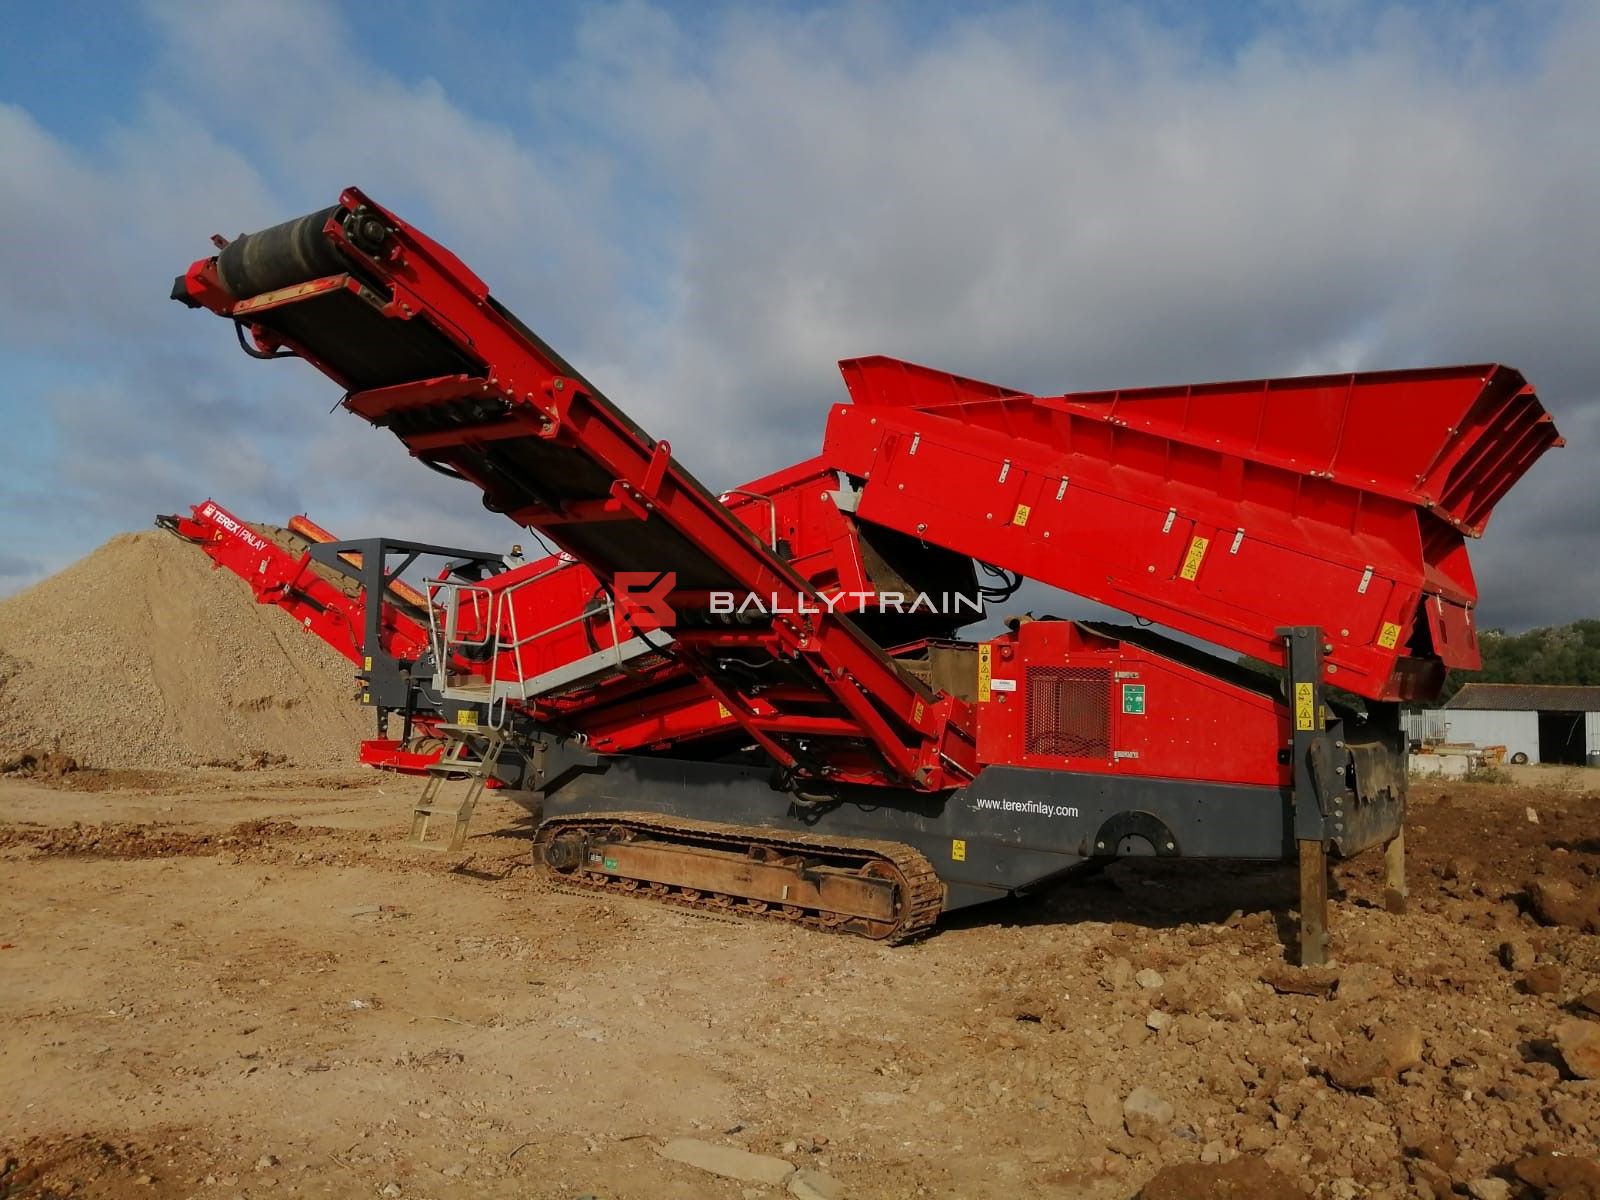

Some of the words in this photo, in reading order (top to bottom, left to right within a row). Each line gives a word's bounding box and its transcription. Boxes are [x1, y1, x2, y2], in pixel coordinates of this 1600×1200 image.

[212, 510, 240, 534] TEREX
[239, 529, 268, 551] FINLAY
[976, 798, 1079, 818] www.terexfinlay.com
